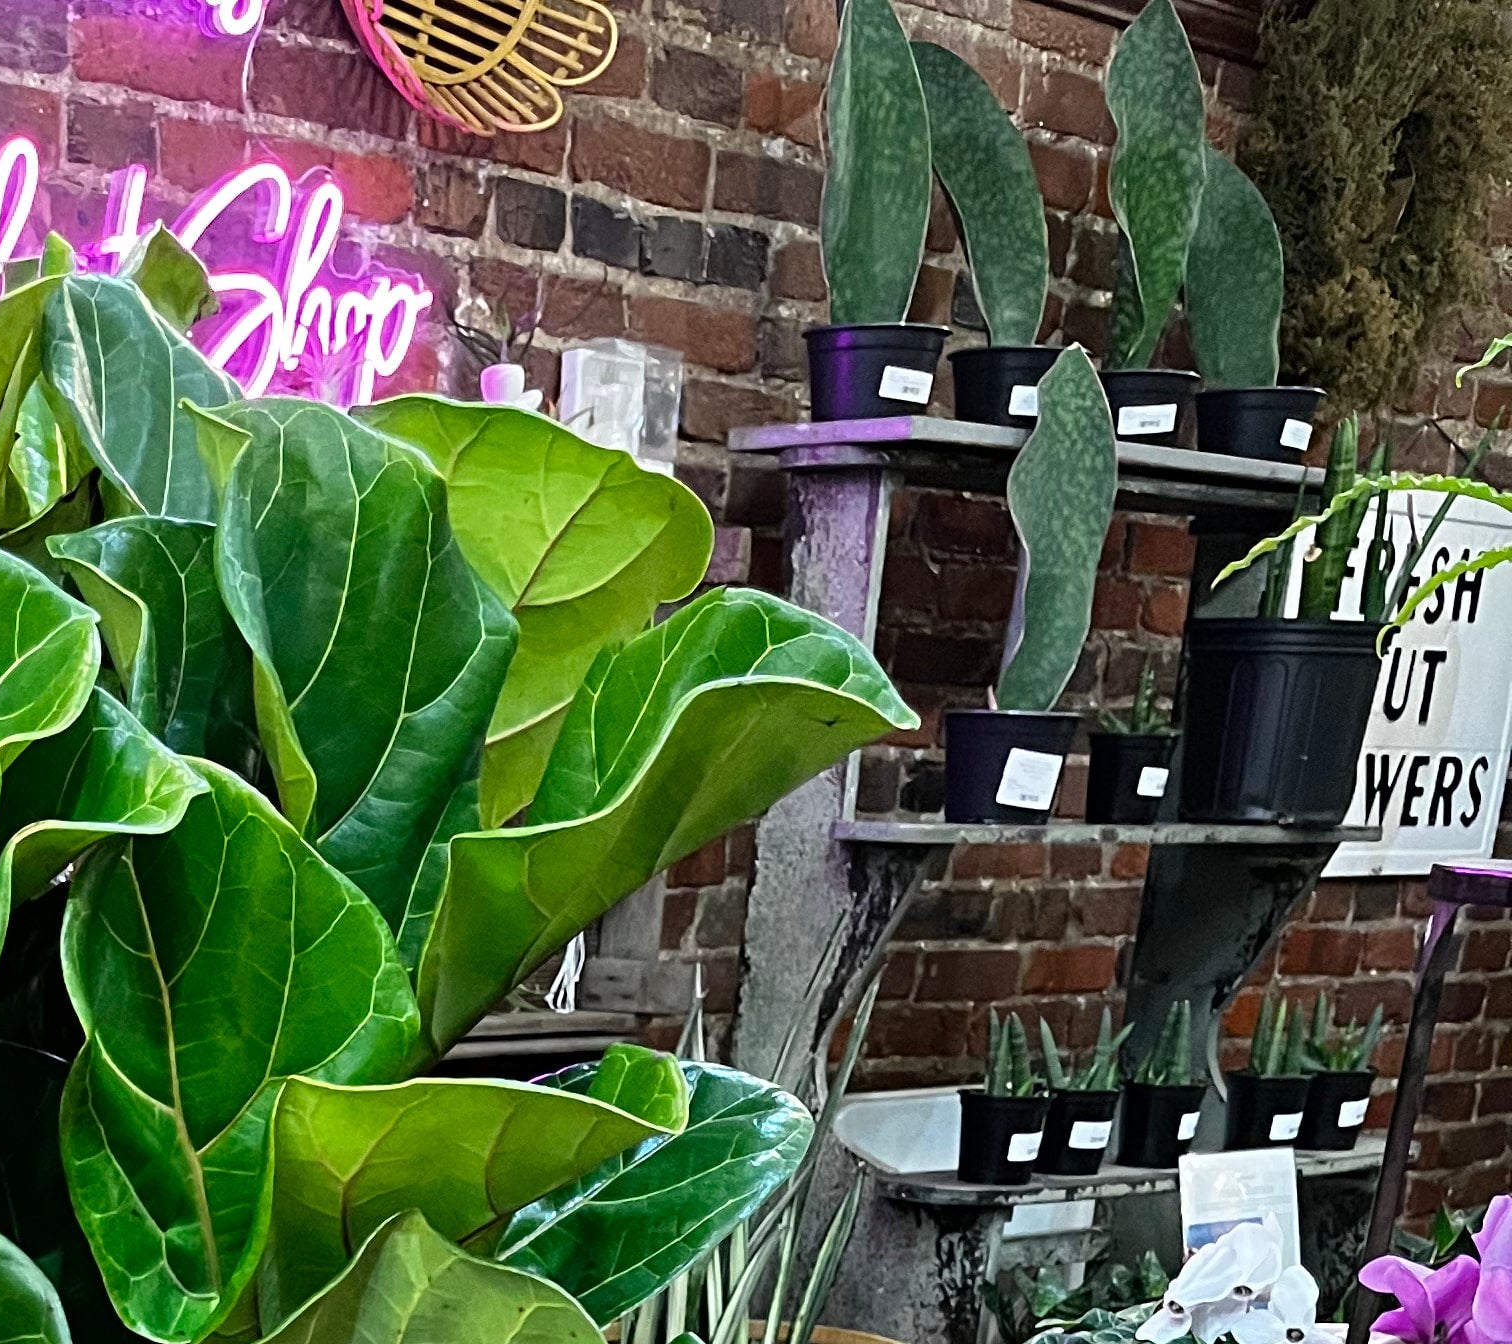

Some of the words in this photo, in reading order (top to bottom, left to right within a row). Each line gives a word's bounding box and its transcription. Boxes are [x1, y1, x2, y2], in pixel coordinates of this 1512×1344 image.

[178, 161, 434, 407] Shop
[1380, 624, 1447, 727] UT
[1365, 752, 1489, 829] WERS
